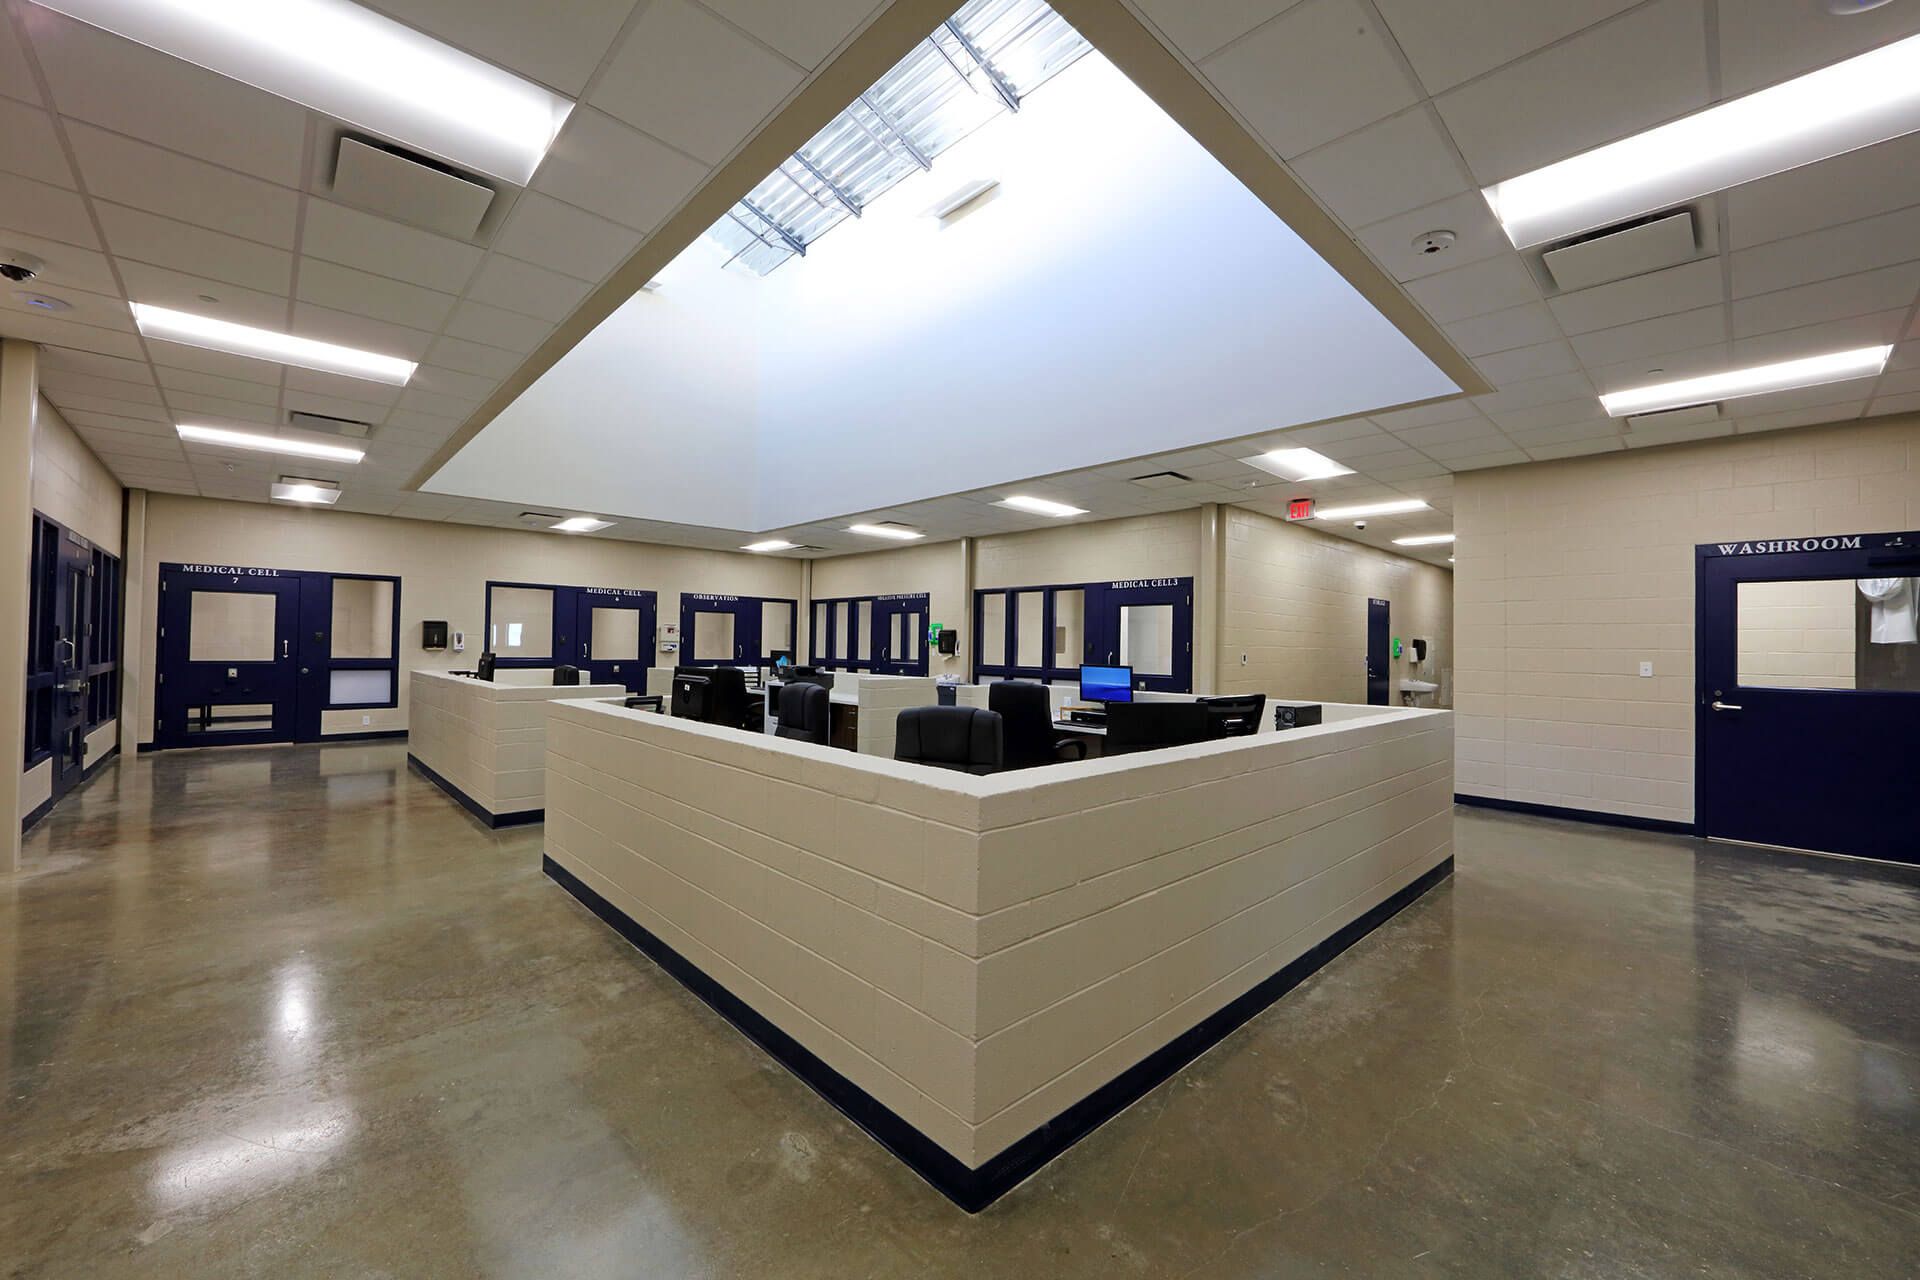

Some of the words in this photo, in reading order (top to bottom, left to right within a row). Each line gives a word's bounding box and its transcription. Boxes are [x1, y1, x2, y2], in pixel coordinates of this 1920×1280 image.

[1290, 501, 1312, 518] EXIT
[1718, 536, 1863, 556] WASHROOM
[182, 564, 244, 575] MEDICAL
[248, 568, 280, 577] CELL
[586, 587, 622, 595] MEDICAL
[1112, 580, 1149, 589] MEDICAL
